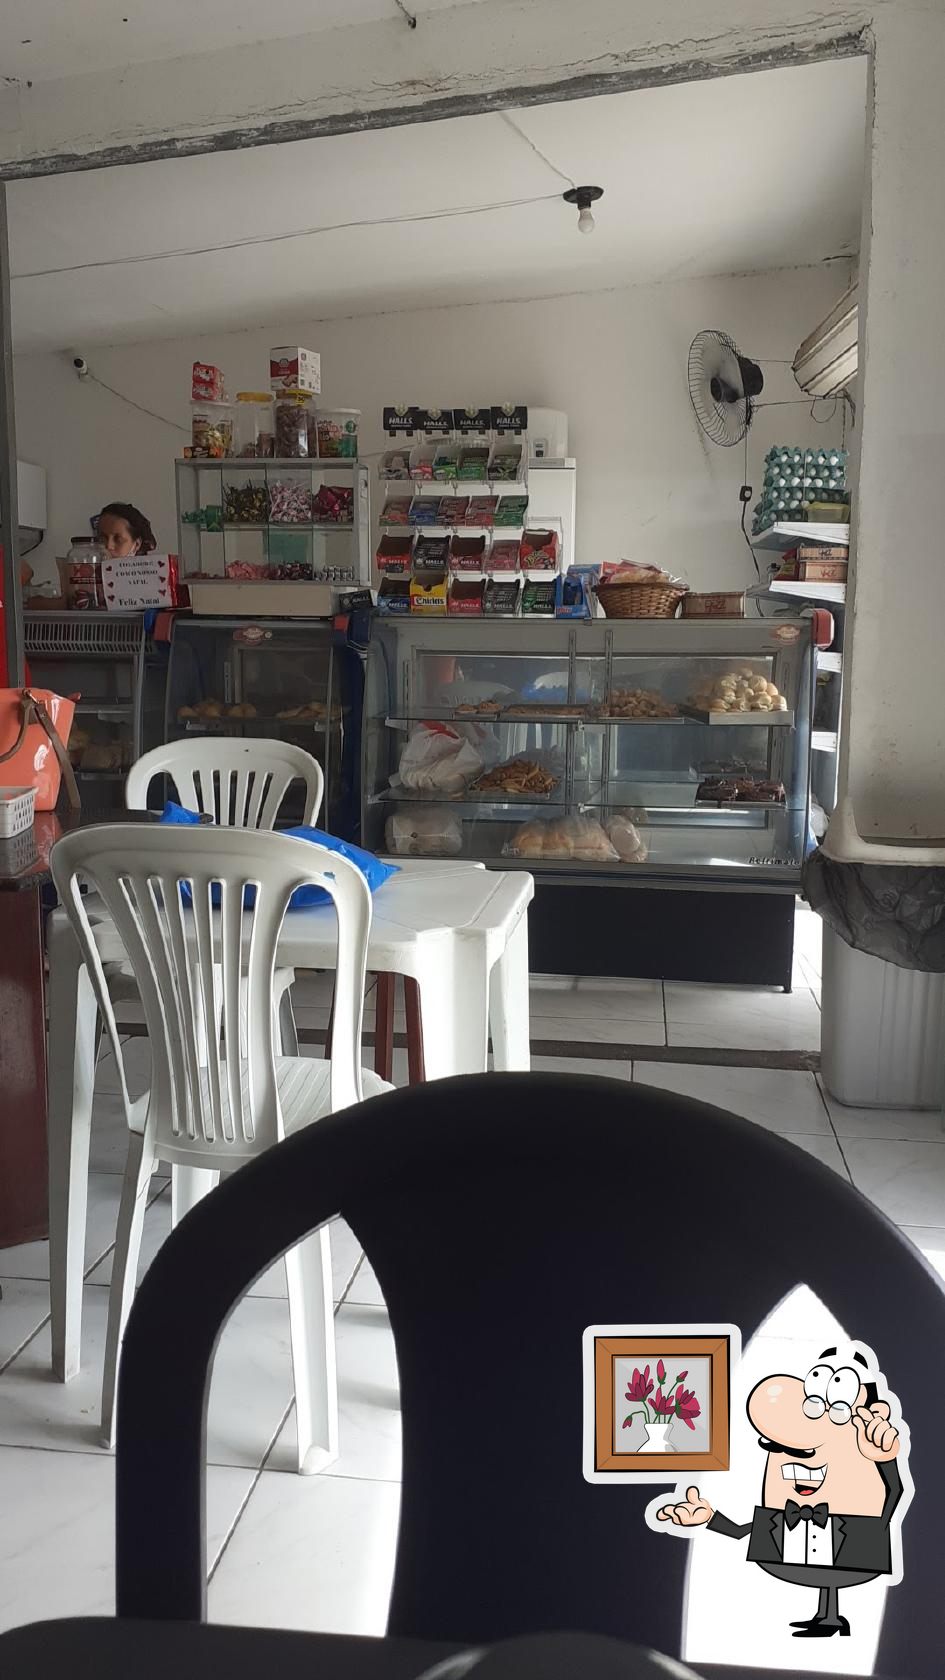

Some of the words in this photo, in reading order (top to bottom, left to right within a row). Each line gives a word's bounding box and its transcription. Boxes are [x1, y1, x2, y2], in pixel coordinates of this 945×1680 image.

[388, 417, 413, 425] HALLS
[496, 417, 521, 425] HALLS
[119, 598, 137, 606] Feliz
